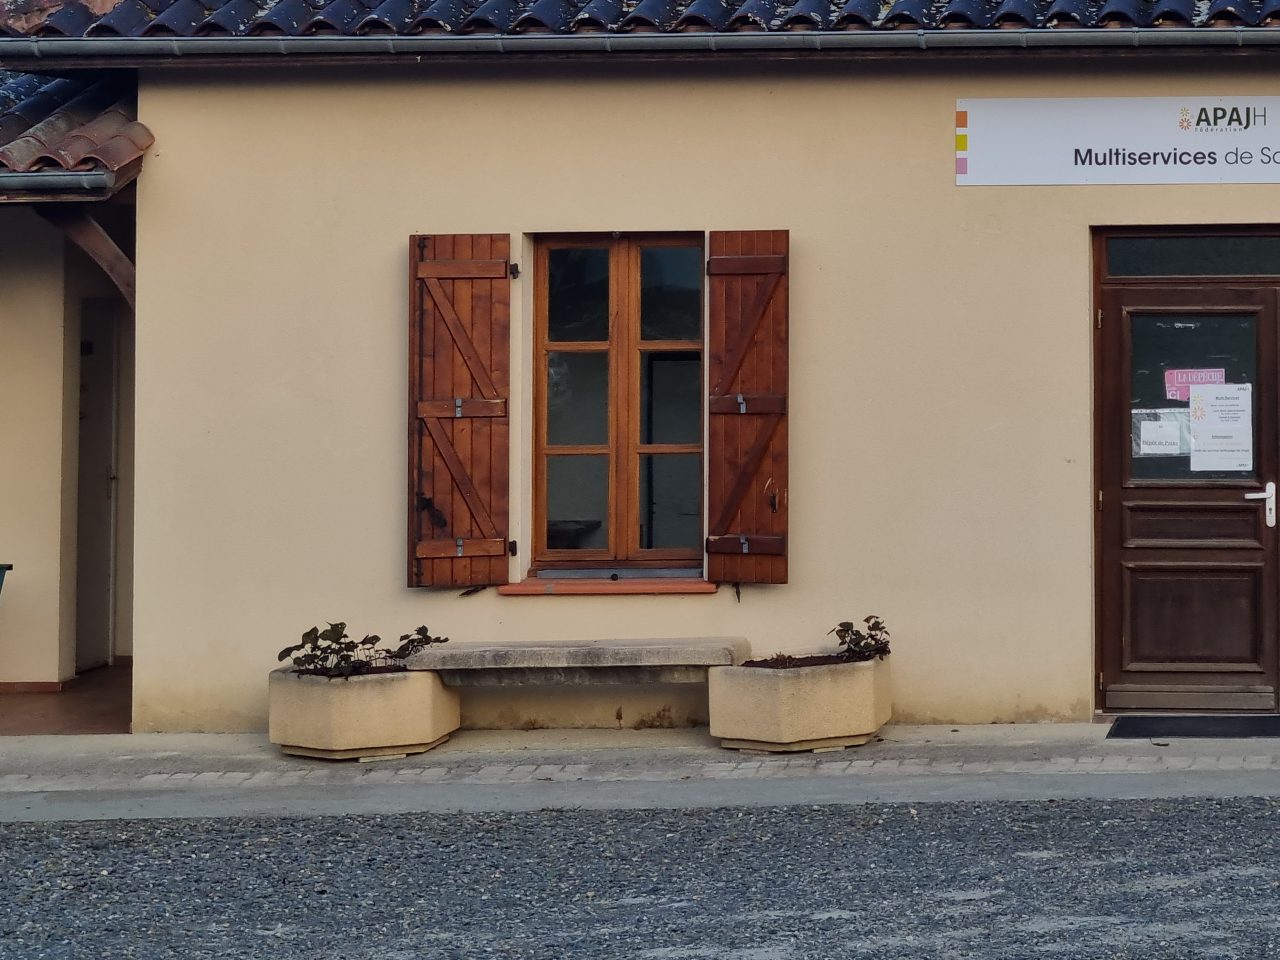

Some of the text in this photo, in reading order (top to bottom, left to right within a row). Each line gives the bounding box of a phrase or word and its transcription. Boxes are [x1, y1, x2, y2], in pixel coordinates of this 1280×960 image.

[1195, 107, 1266, 130] APAJH
[1074, 147, 1217, 166] Multiservices
[1224, 147, 1253, 164] de
